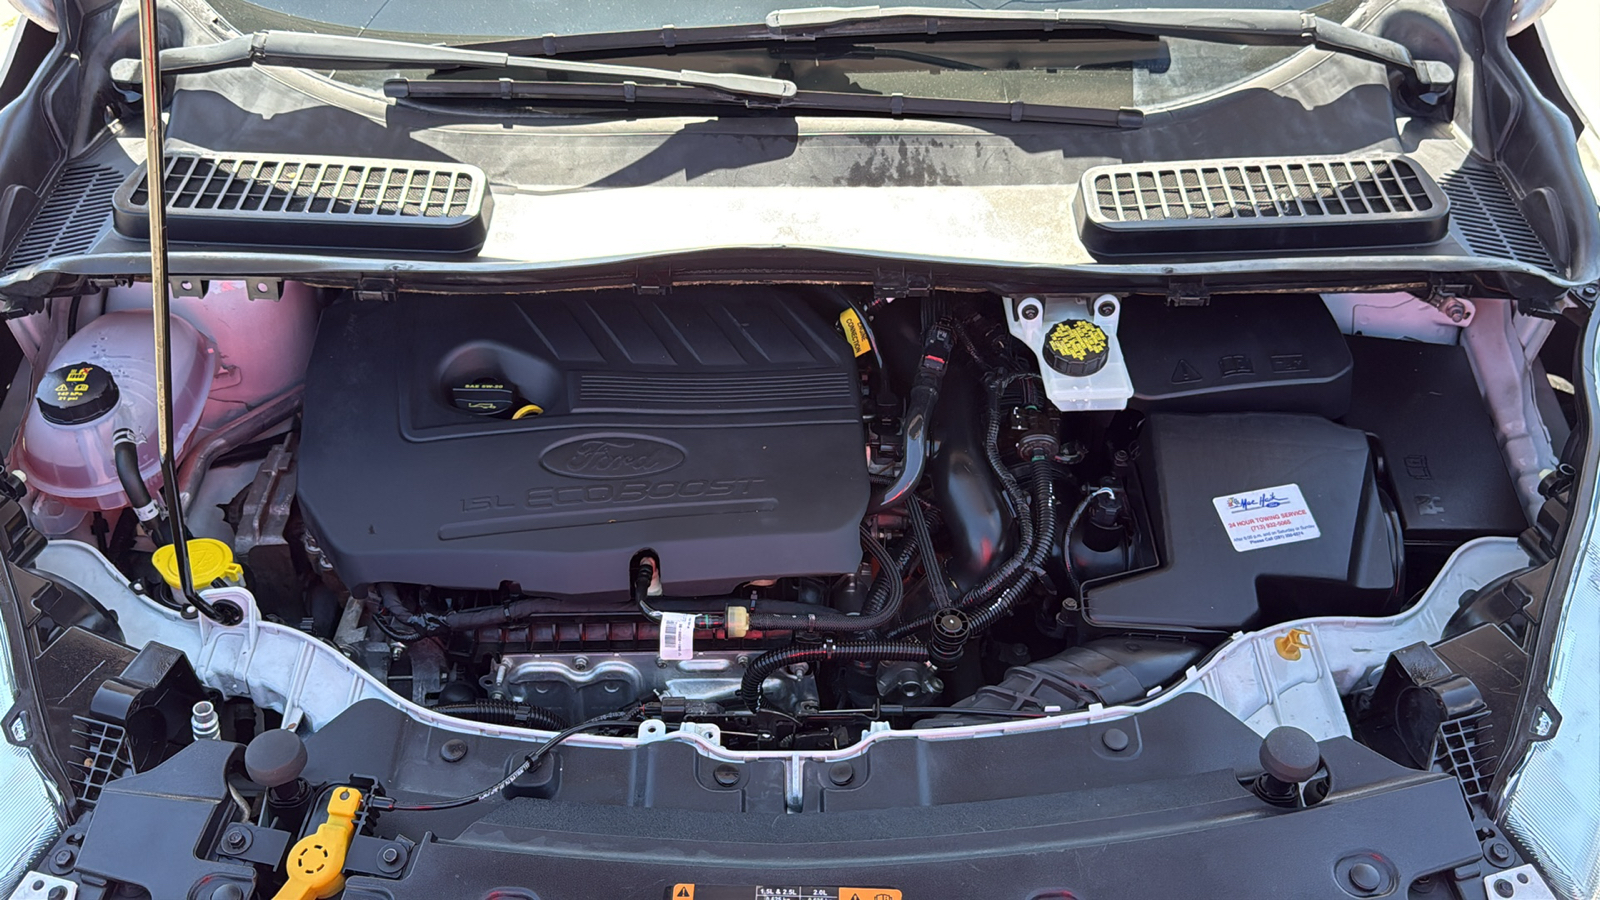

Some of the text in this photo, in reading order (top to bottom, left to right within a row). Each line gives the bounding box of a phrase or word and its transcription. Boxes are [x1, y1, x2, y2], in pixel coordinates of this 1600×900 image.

[846, 318, 862, 353] CONNECTION
[566, 441, 662, 472] Ford
[524, 478, 766, 510] ECOBOOST
[1237, 519, 1255, 527] HOUR
[1255, 514, 1280, 523] TOWING
[1280, 509, 1307, 519] SERVICE
[1251, 524, 1266, 532] (713)
